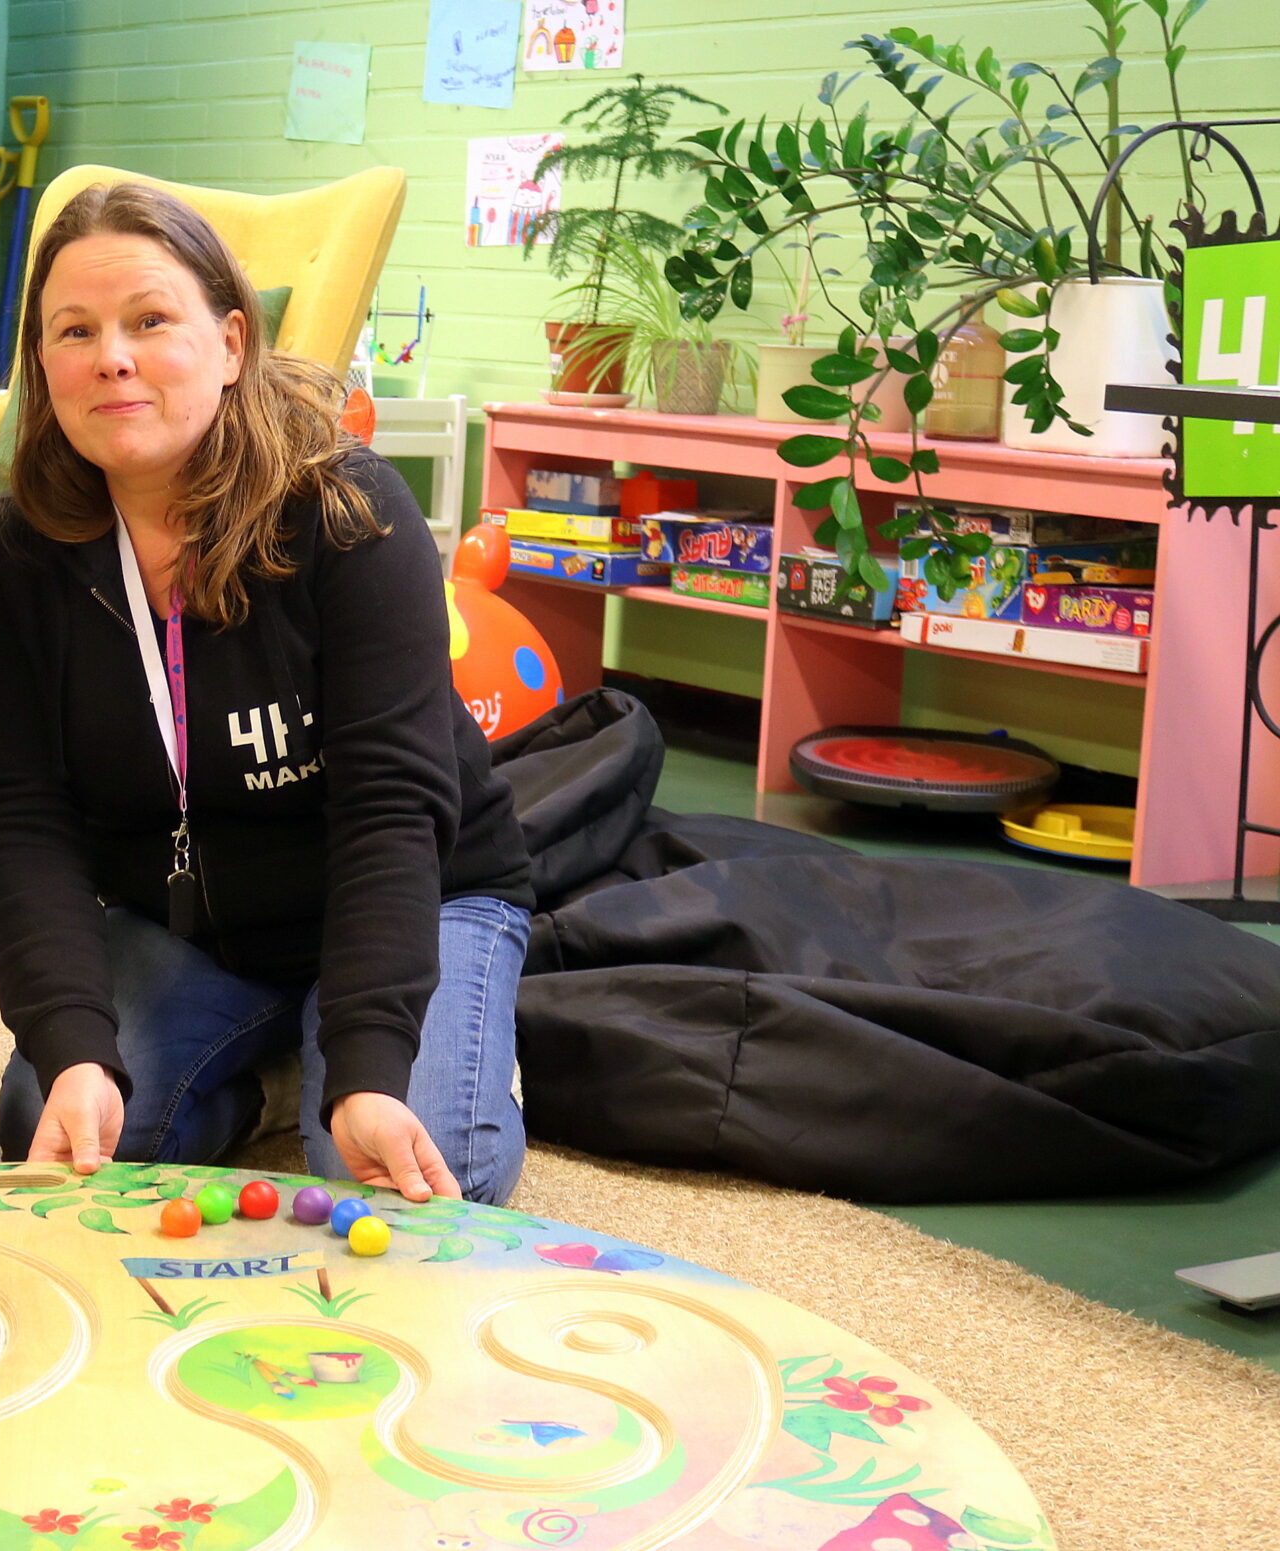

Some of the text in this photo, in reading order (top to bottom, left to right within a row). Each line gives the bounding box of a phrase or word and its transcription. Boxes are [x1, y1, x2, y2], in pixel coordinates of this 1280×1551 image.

[1197, 295, 1280, 435] 4
[812, 579, 838, 592] FACE
[1060, 594, 1117, 624] PARTY
[932, 622, 953, 635] goki
[244, 749, 326, 790] MAK
[155, 1253, 299, 1278] START
